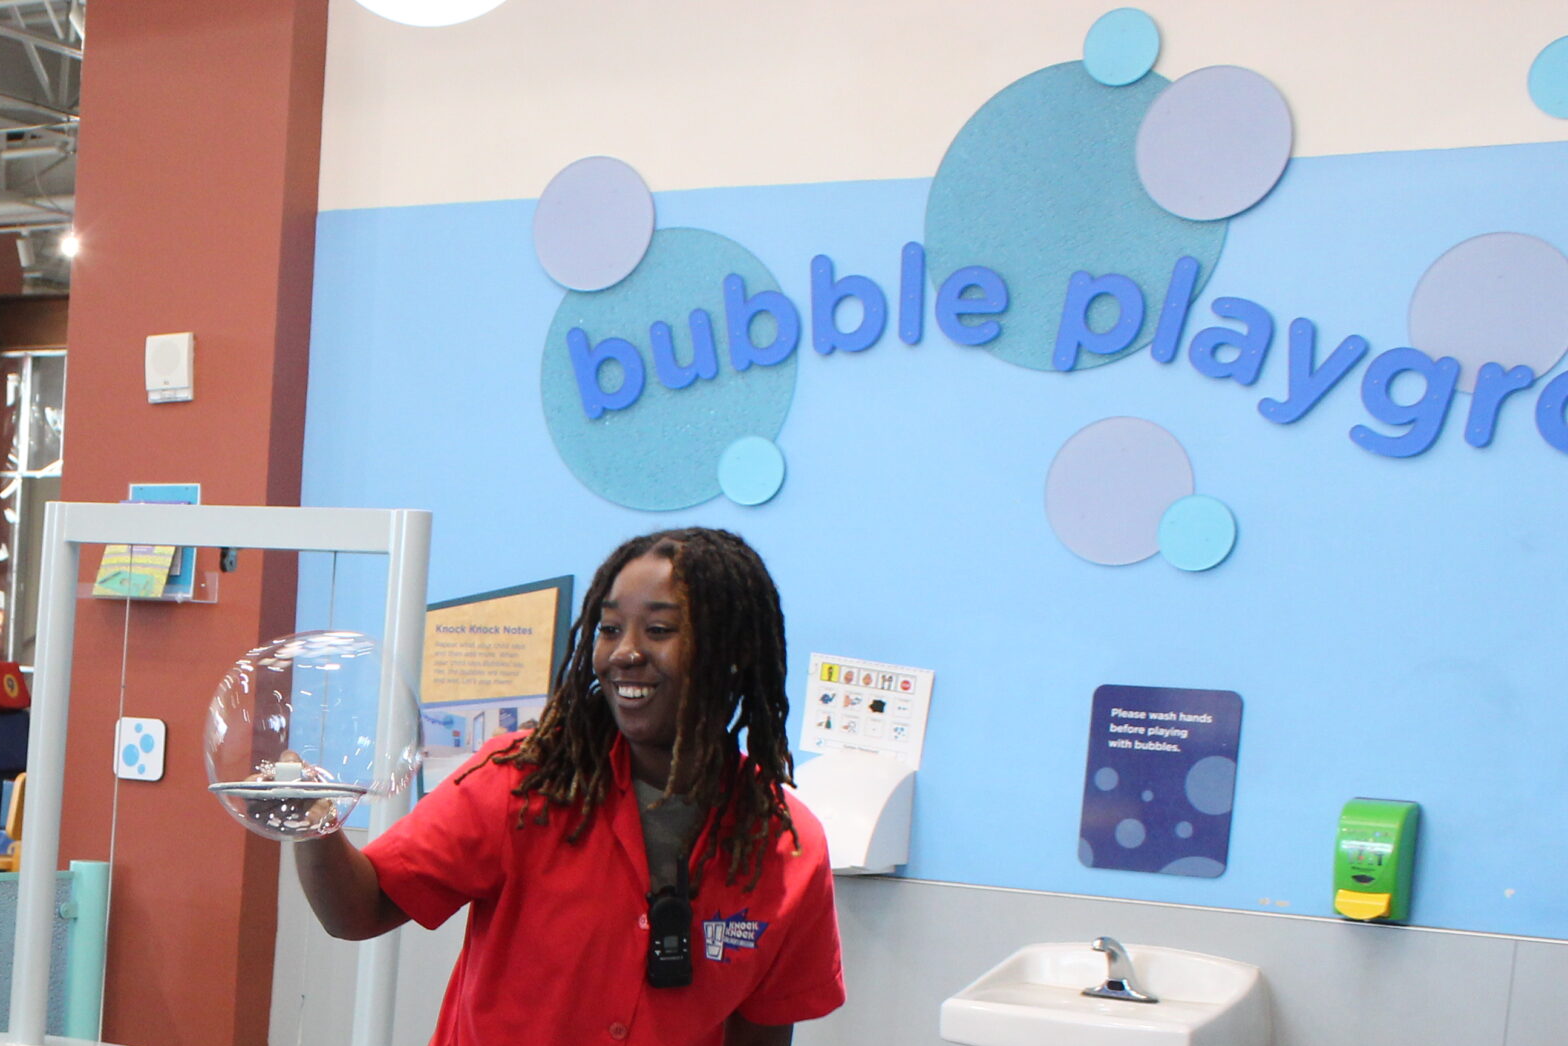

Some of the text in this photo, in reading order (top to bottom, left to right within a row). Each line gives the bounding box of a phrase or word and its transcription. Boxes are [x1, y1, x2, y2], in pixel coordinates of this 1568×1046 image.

[565, 241, 1010, 421] bubble
[435, 624, 533, 635] Knock Knock Notes
[1110, 708, 1213, 723] Please wash hands
[1109, 723, 1189, 739] before playing
[1108, 739, 1181, 752] with bubbles.
[728, 920, 759, 930] KNOCK
[724, 927, 755, 940] KNOCK
